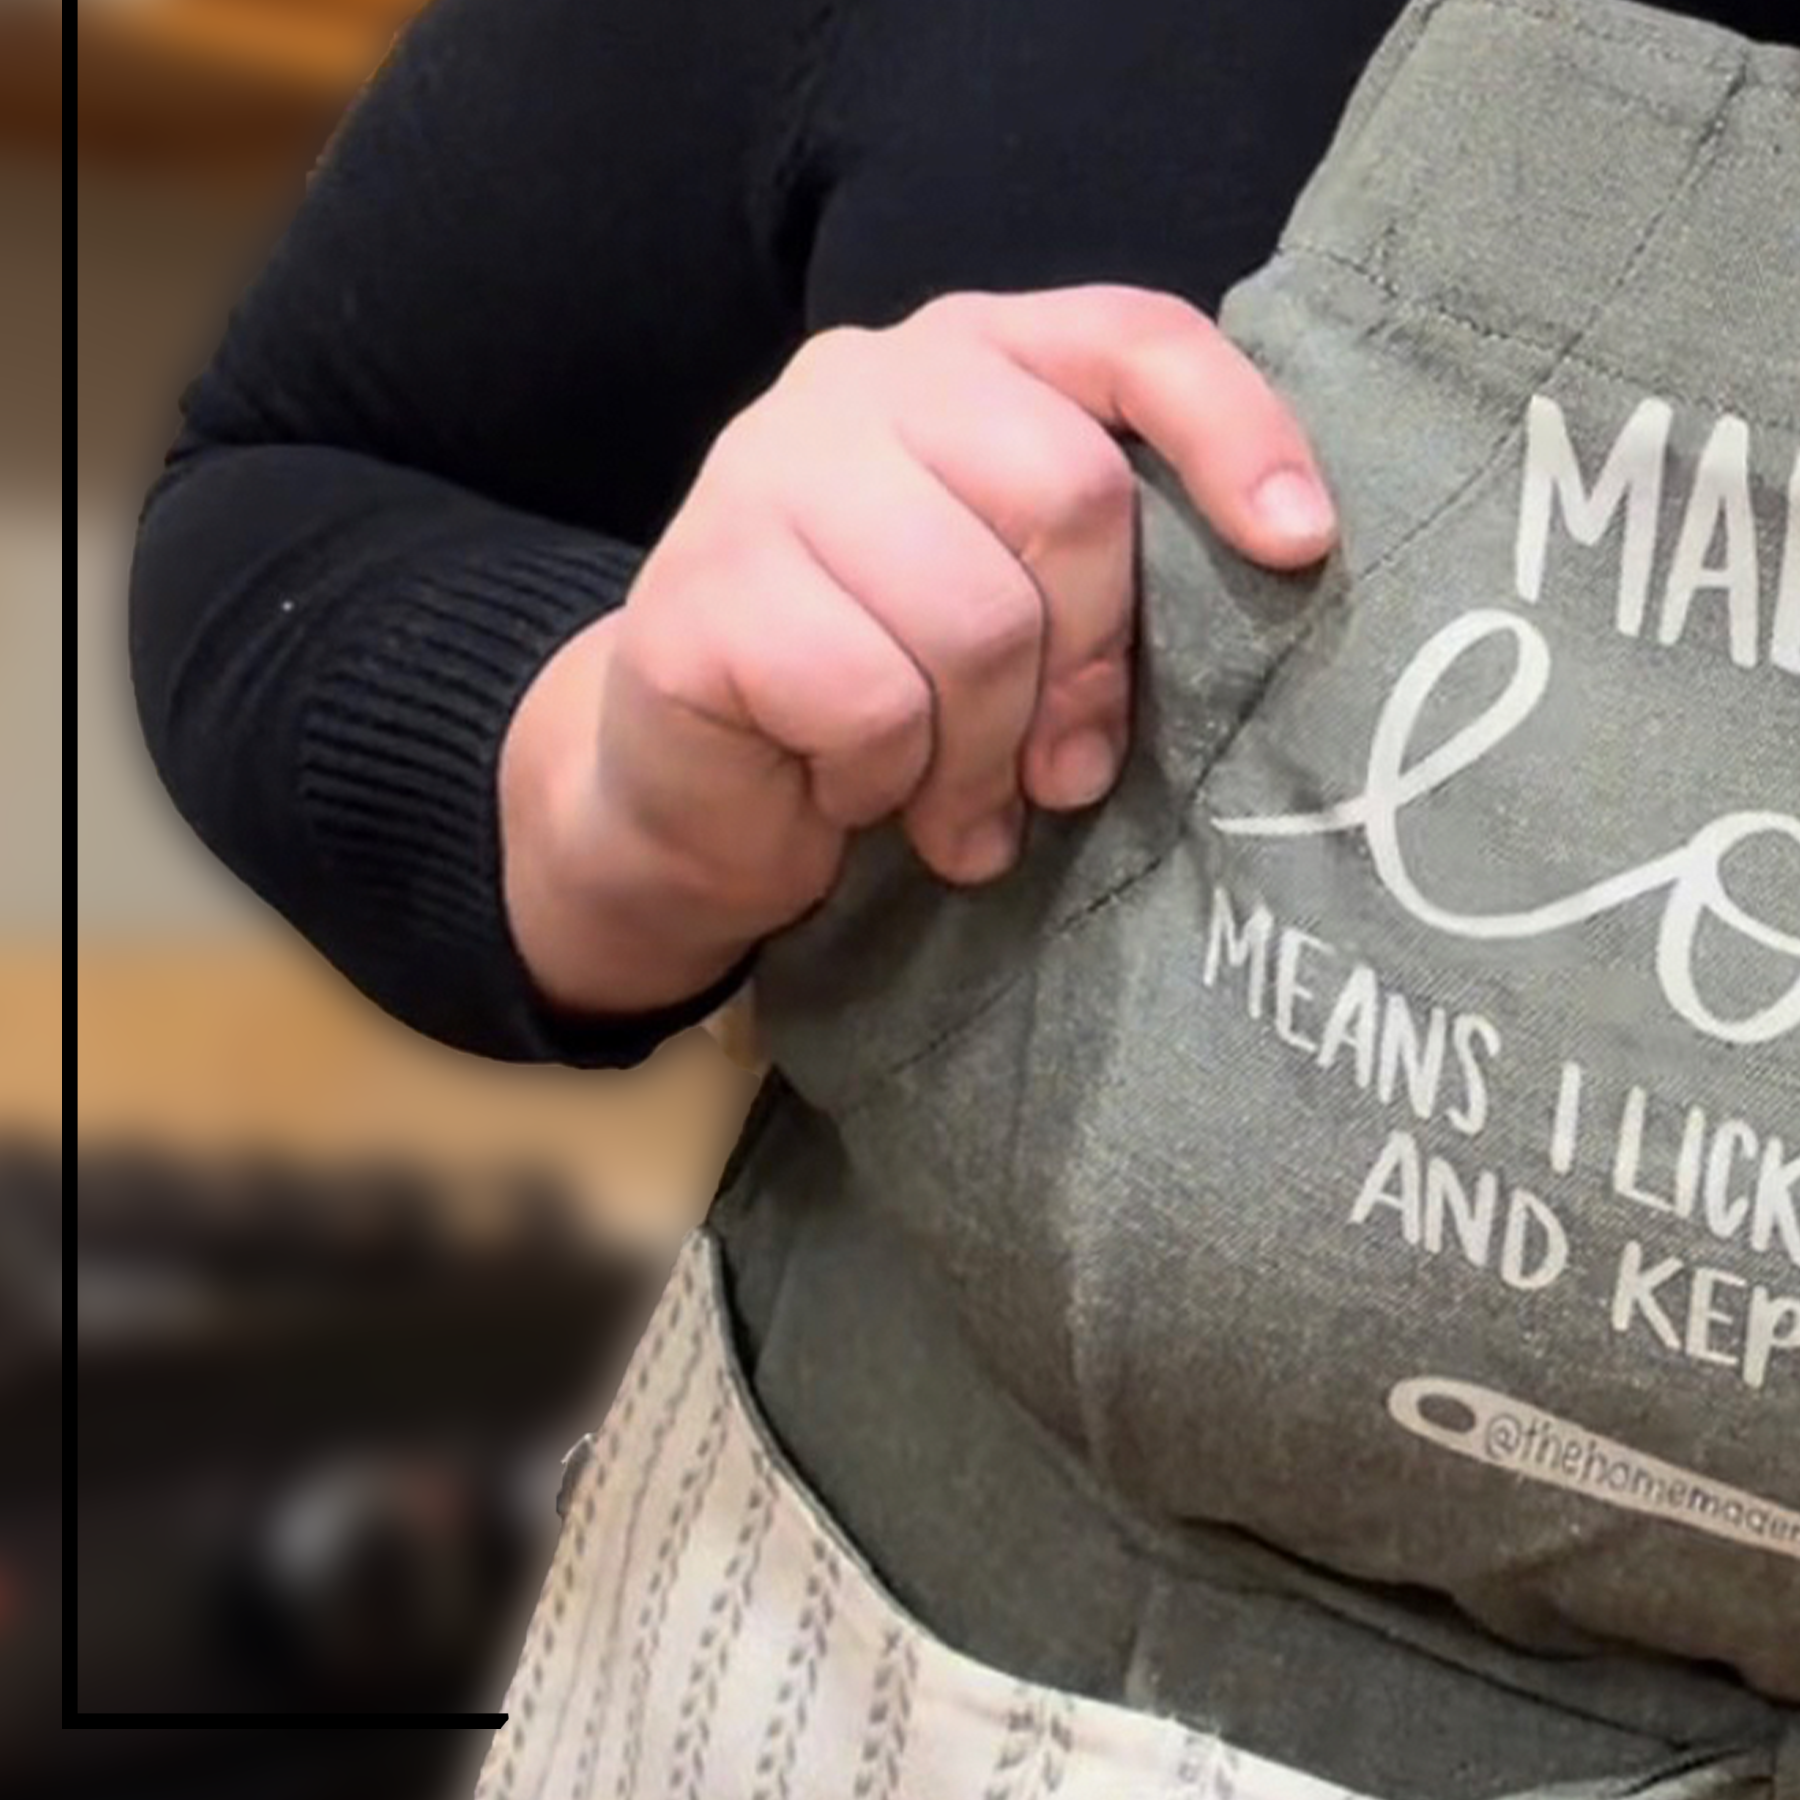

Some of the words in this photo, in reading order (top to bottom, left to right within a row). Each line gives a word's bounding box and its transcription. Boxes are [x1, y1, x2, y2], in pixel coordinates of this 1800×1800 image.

[1203, 887, 1502, 1135] MEANS
[1551, 1061, 1582, 1173] I
[1349, 1132, 1569, 1291] AND
